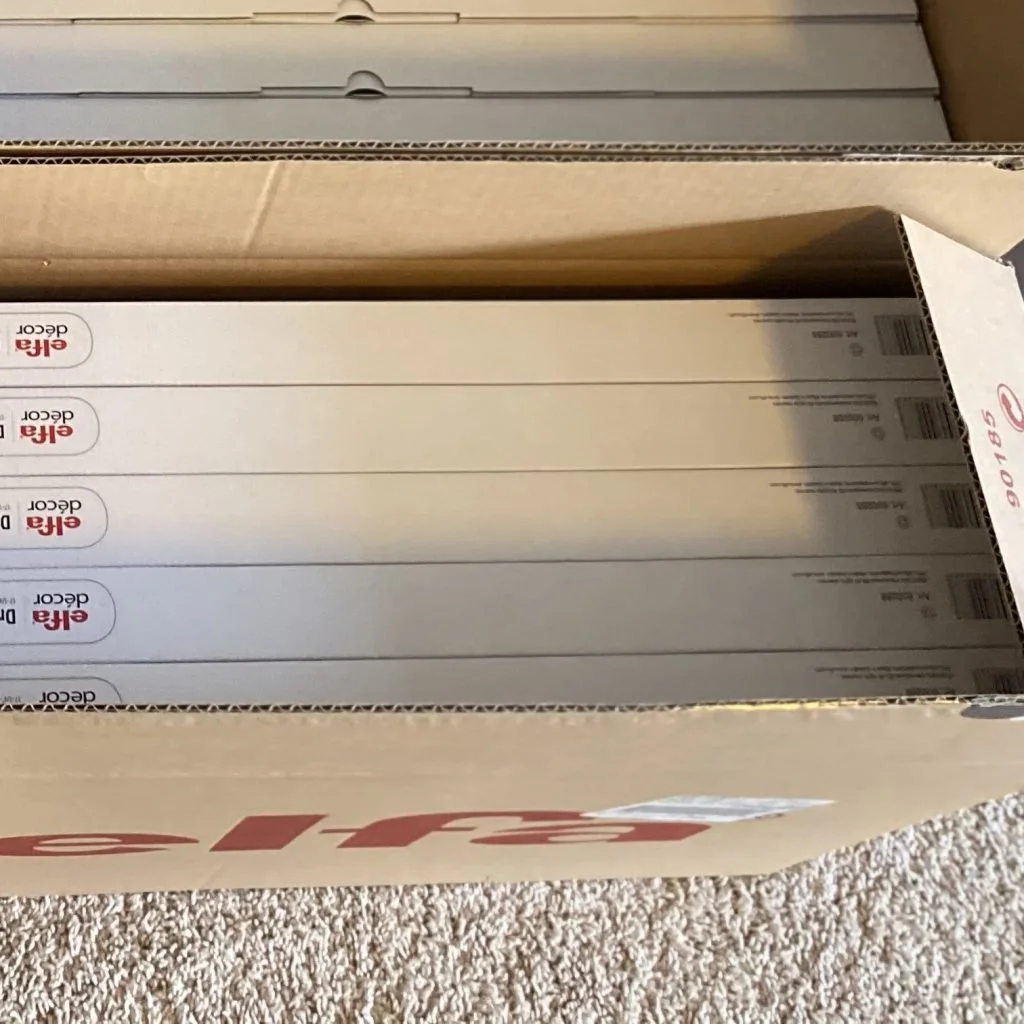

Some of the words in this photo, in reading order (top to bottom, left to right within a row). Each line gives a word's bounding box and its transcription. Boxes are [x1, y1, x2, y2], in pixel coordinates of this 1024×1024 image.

[16, 324, 68, 338] décor
[15, 339, 68, 357] elfa
[21, 410, 74, 424] décor
[20, 426, 73, 444] elfa
[981, 409, 1020, 509] 90185
[27, 499, 82, 514] décor
[27, 516, 81, 536] elfa
[34, 593, 89, 608] décor
[32, 610, 89, 631] elfa
